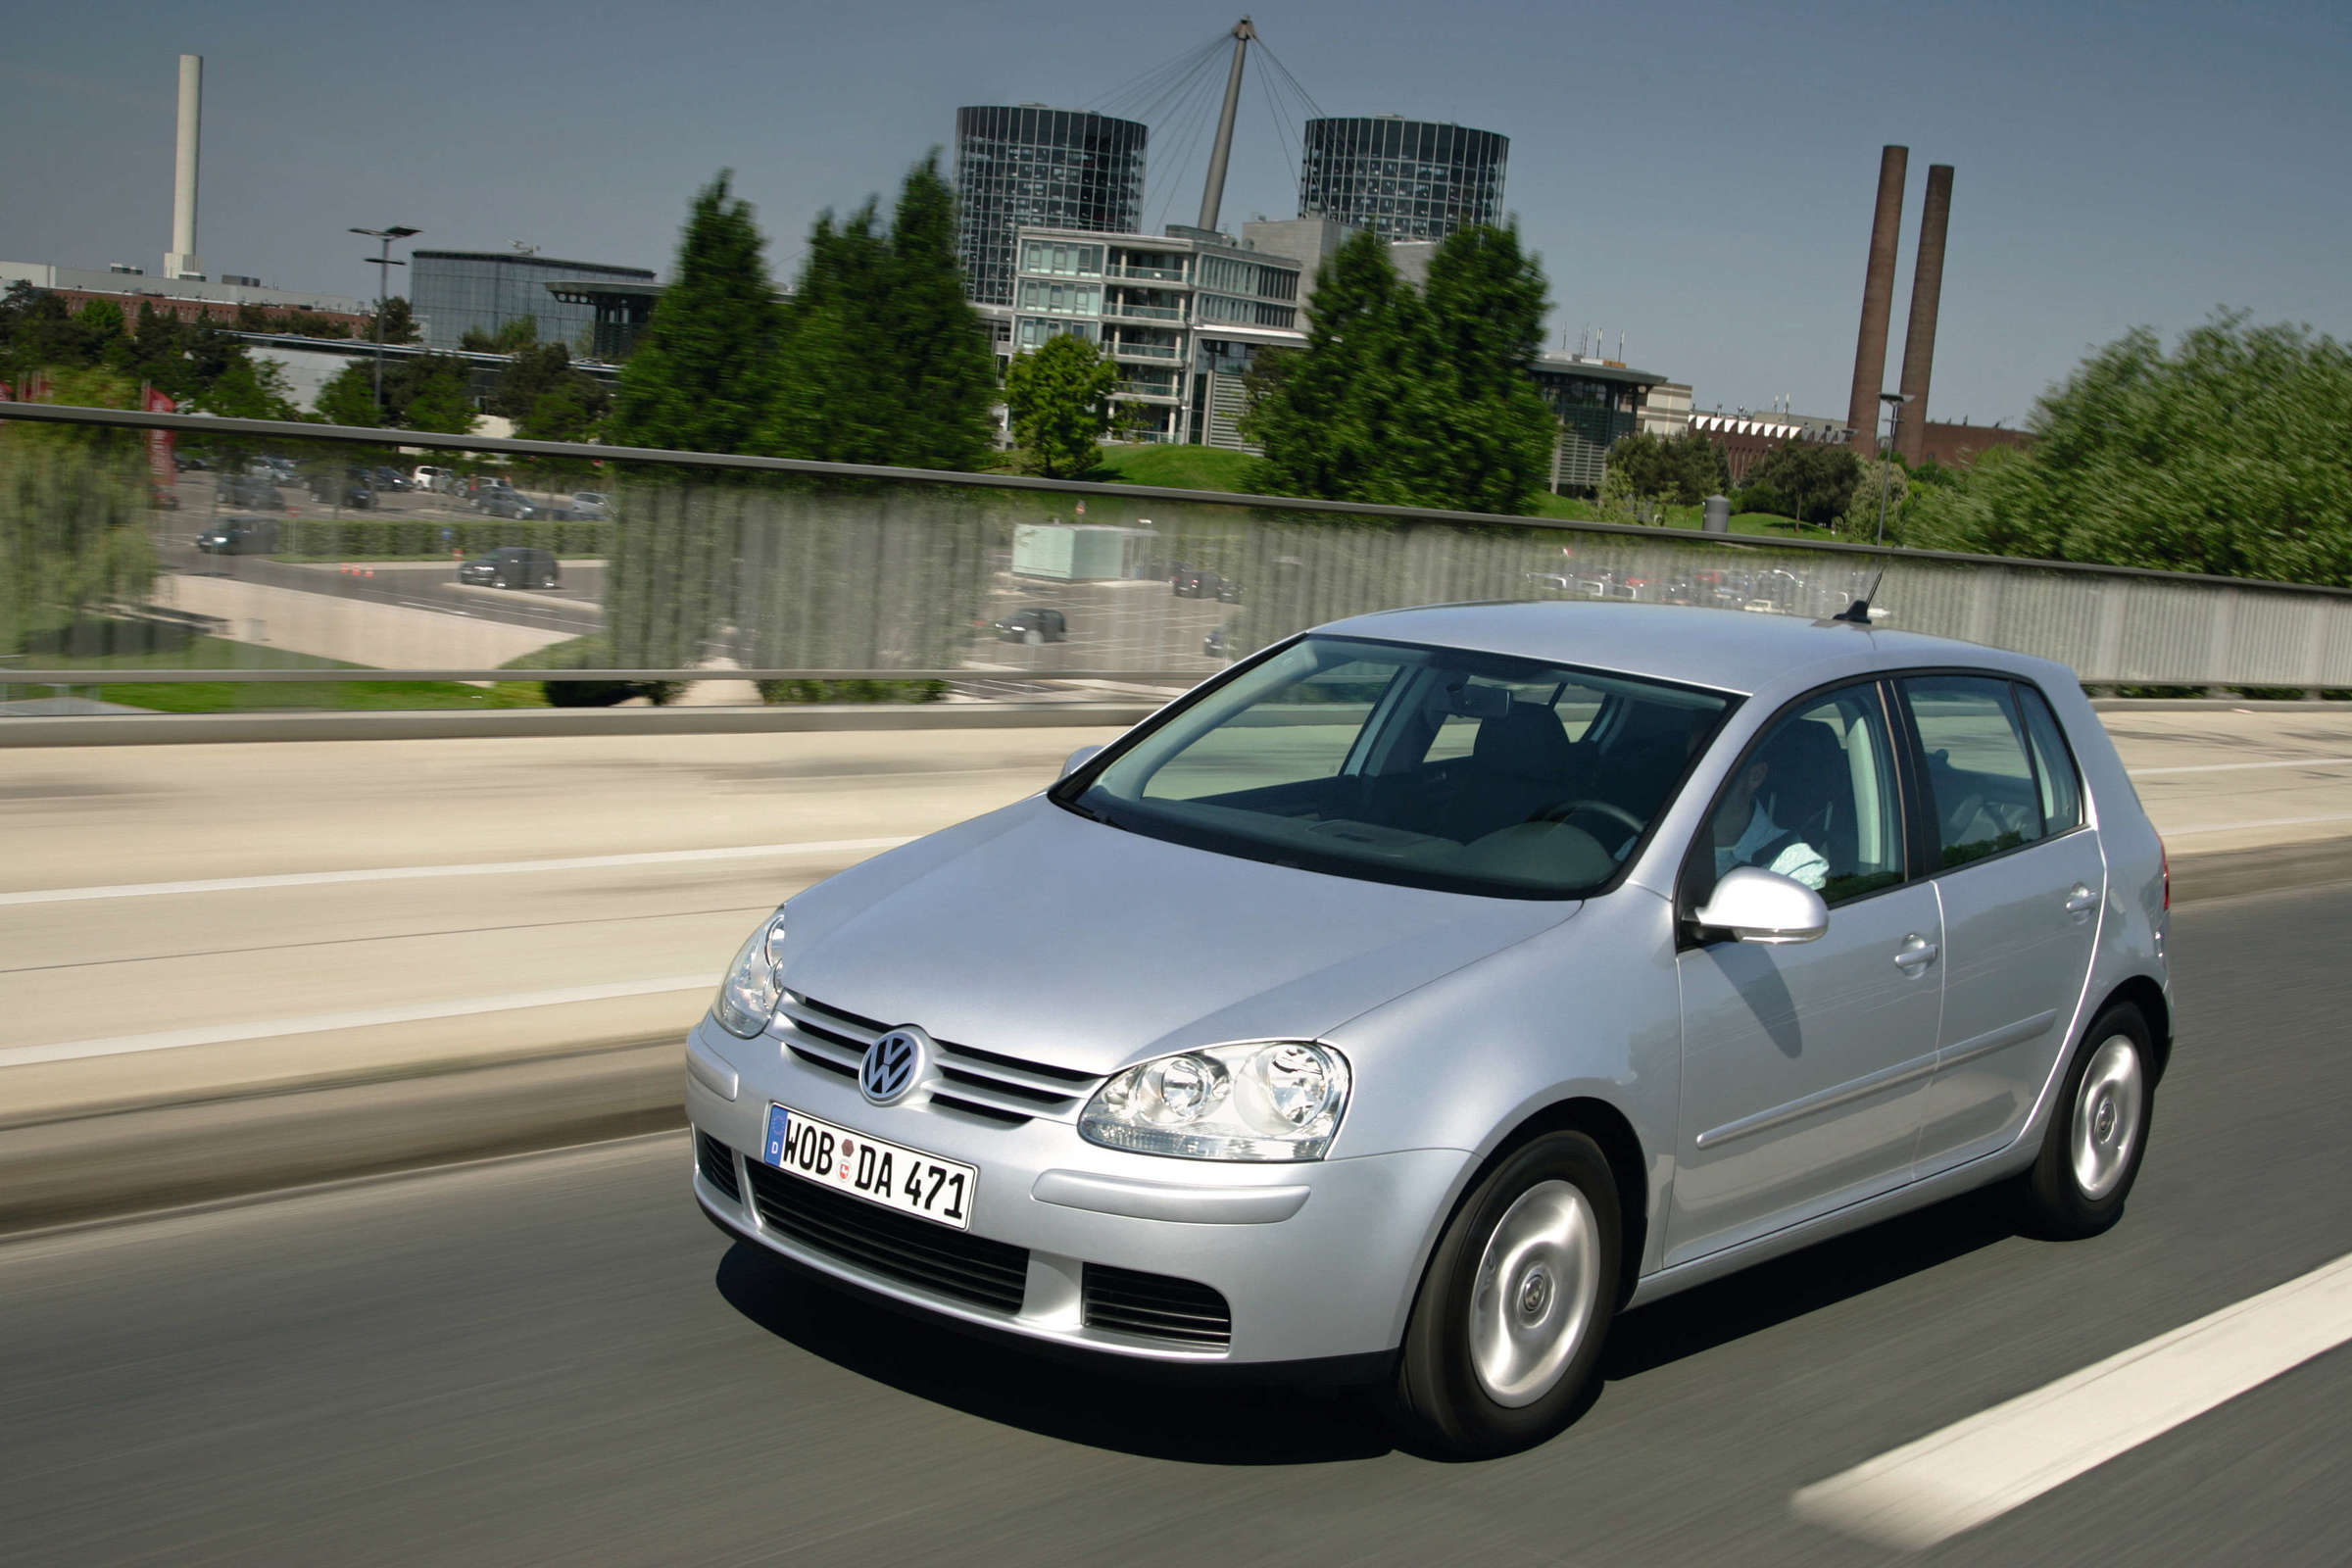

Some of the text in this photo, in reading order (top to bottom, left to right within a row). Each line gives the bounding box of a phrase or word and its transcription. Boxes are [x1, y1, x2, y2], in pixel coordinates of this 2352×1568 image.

[863, 1034, 919, 1097] VW
[771, 1141, 778, 1154] D
[783, 1119, 965, 1219] WOB DA 471
